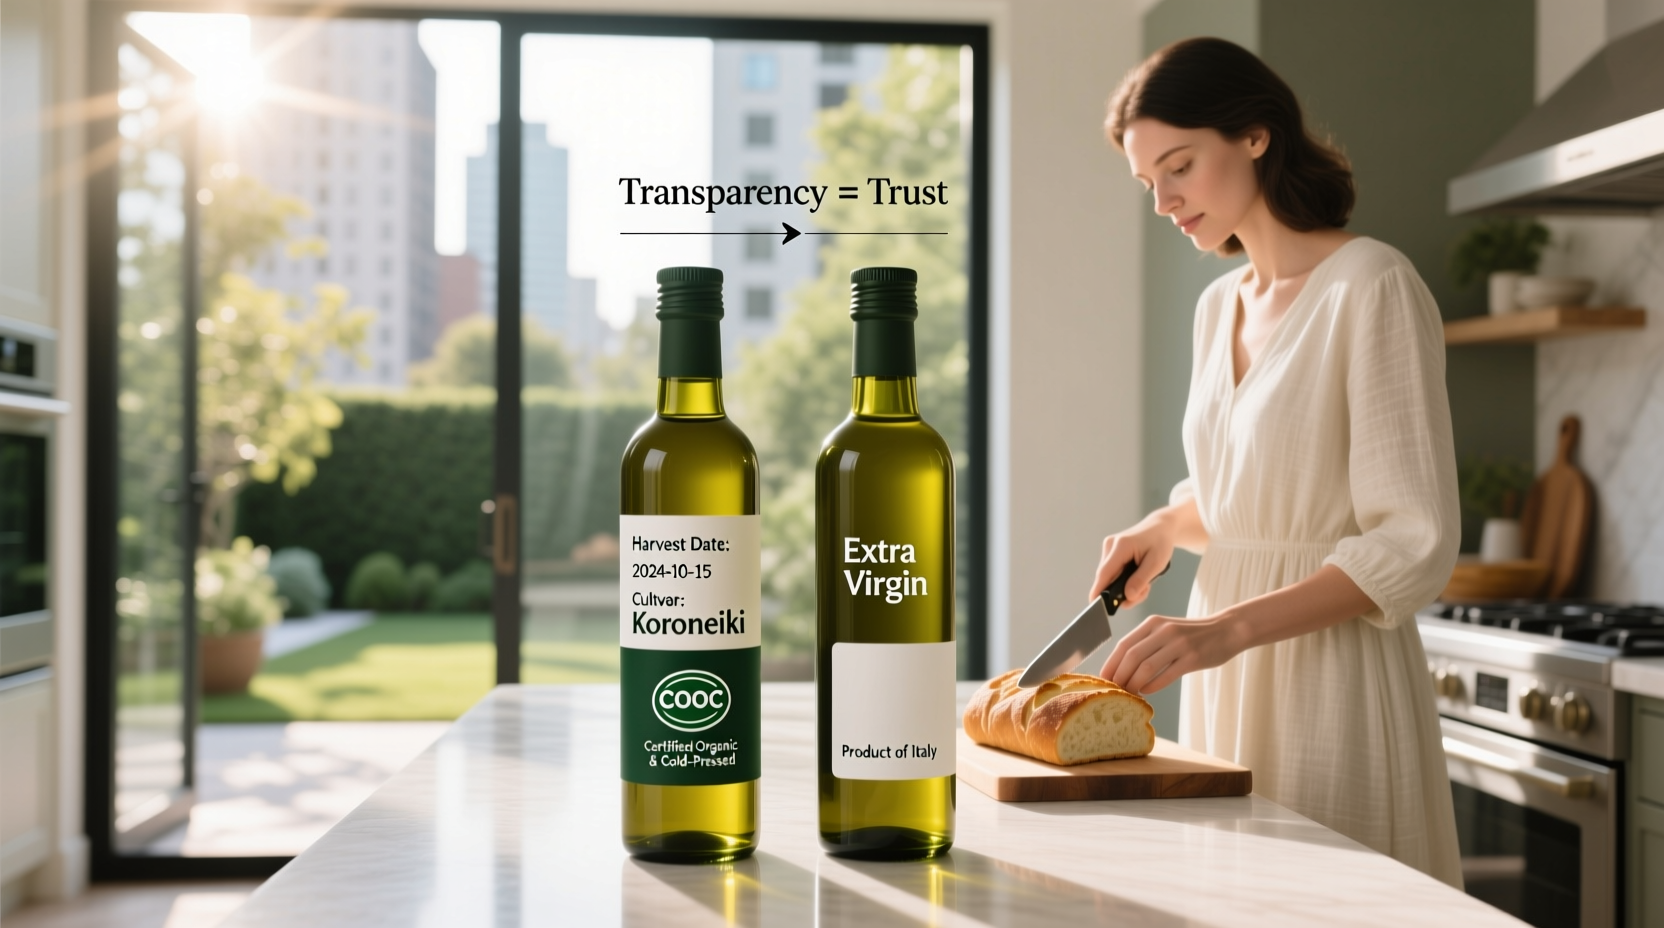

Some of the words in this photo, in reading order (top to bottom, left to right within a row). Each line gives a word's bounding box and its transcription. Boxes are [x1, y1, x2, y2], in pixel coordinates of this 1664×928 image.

[632, 536, 686, 551] Harvest
[691, 536, 730, 552] Date:
[844, 537, 916, 563] Extra
[632, 563, 712, 579] 2024-10-15
[843, 569, 928, 604] Virgin
[633, 609, 745, 635] Koroneiki
[659, 689, 724, 709] COOC
[842, 744, 891, 759] Product
[895, 744, 908, 758] of
[912, 743, 937, 760] Italy
[649, 755, 657, 767] &
